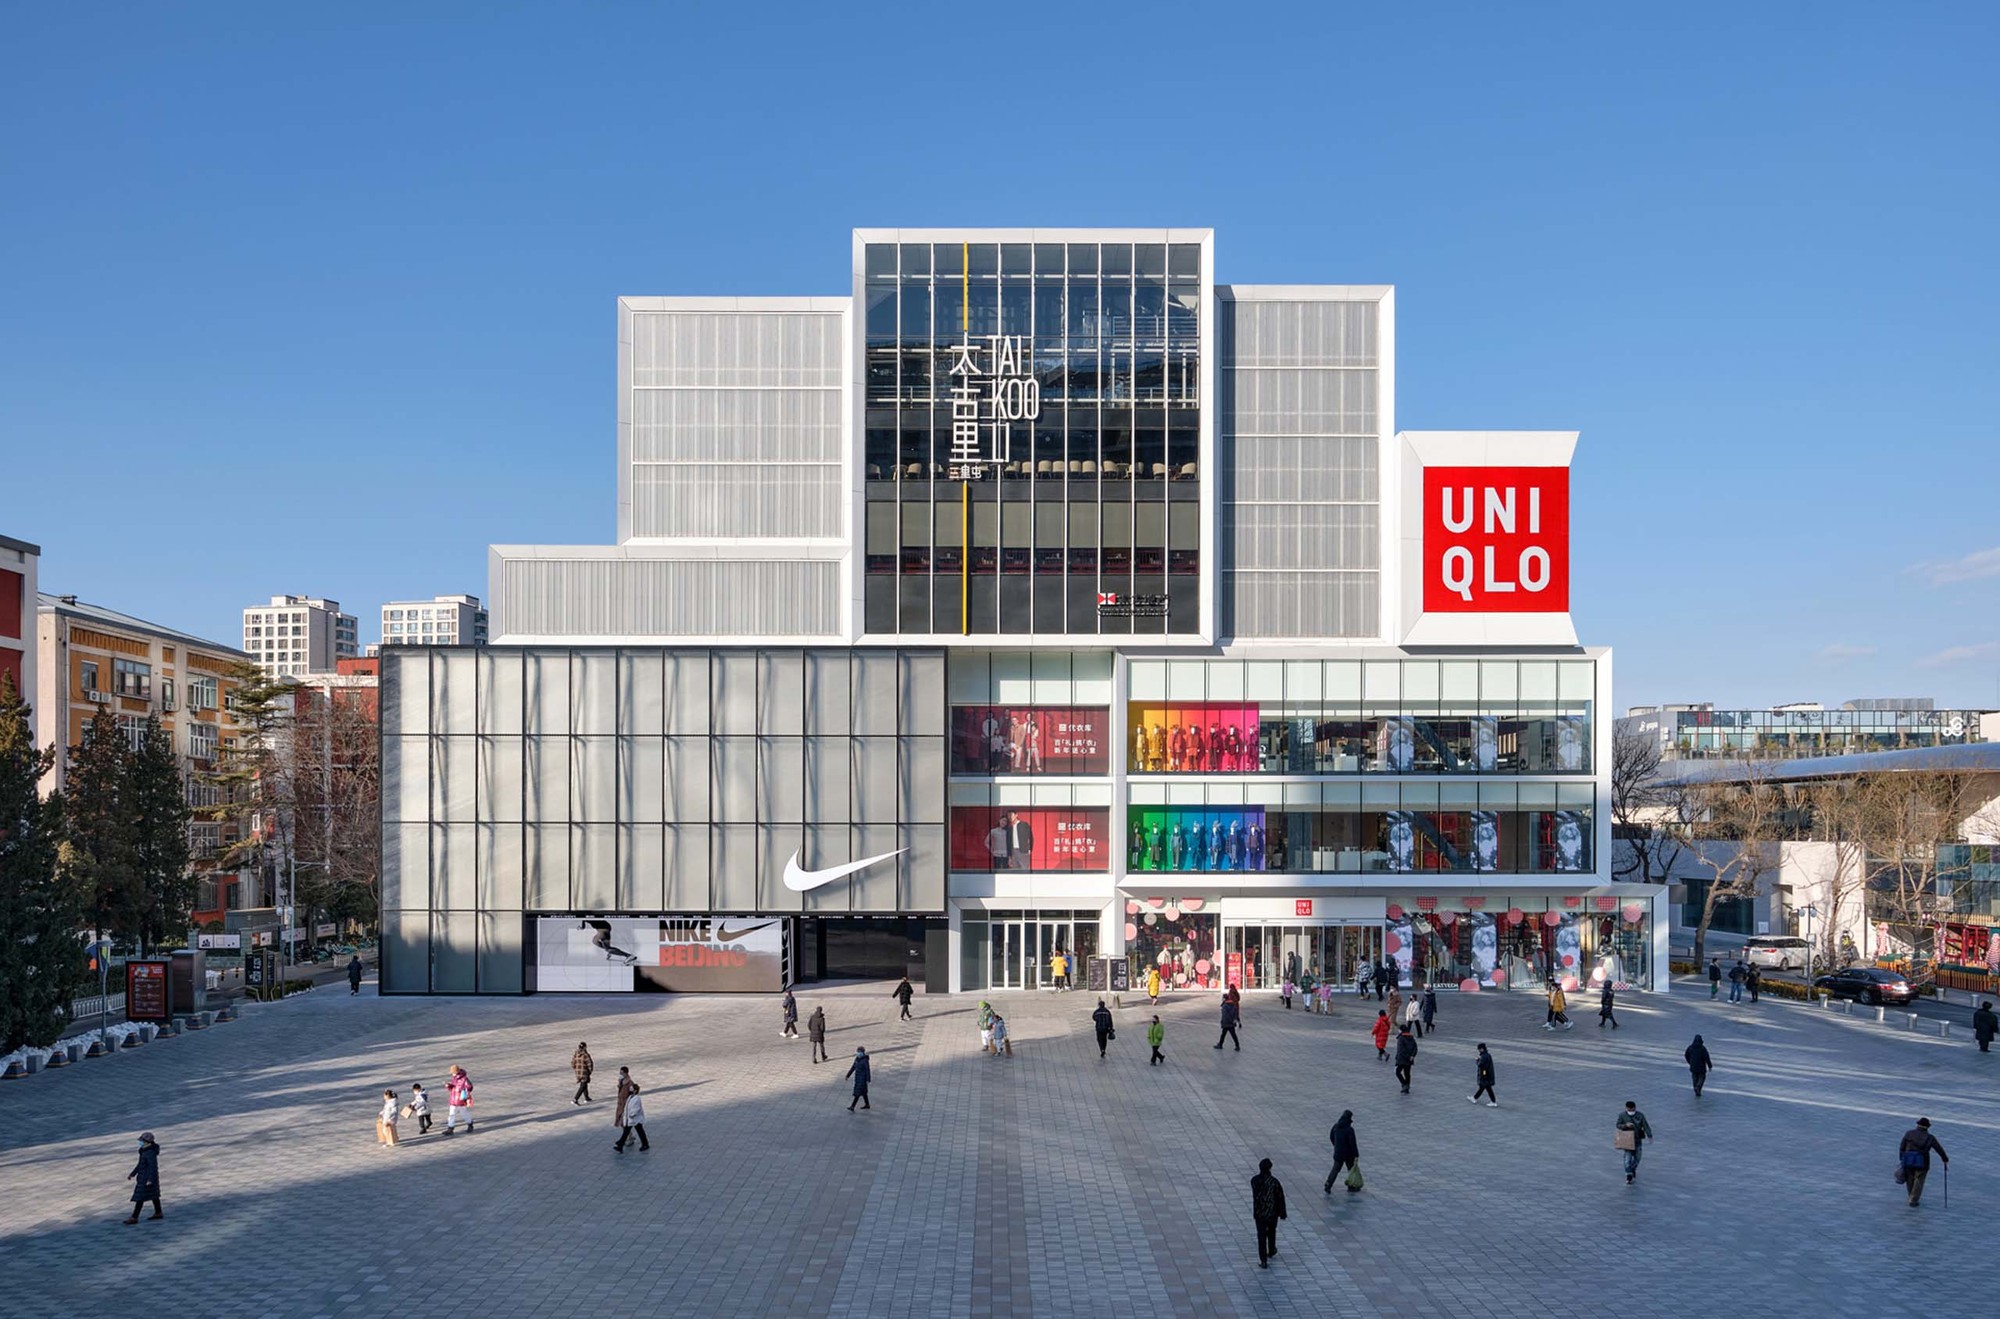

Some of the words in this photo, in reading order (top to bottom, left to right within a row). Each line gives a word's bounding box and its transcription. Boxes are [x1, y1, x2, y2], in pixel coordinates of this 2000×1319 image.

[986, 334, 1022, 376] TAI
[949, 331, 982, 463] 太古里
[991, 378, 1040, 420] KOO
[1442, 487, 1540, 534] UNI
[1442, 545, 1551, 601] QLO
[659, 919, 712, 942] NIKE
[659, 943, 748, 968] BEIJING
